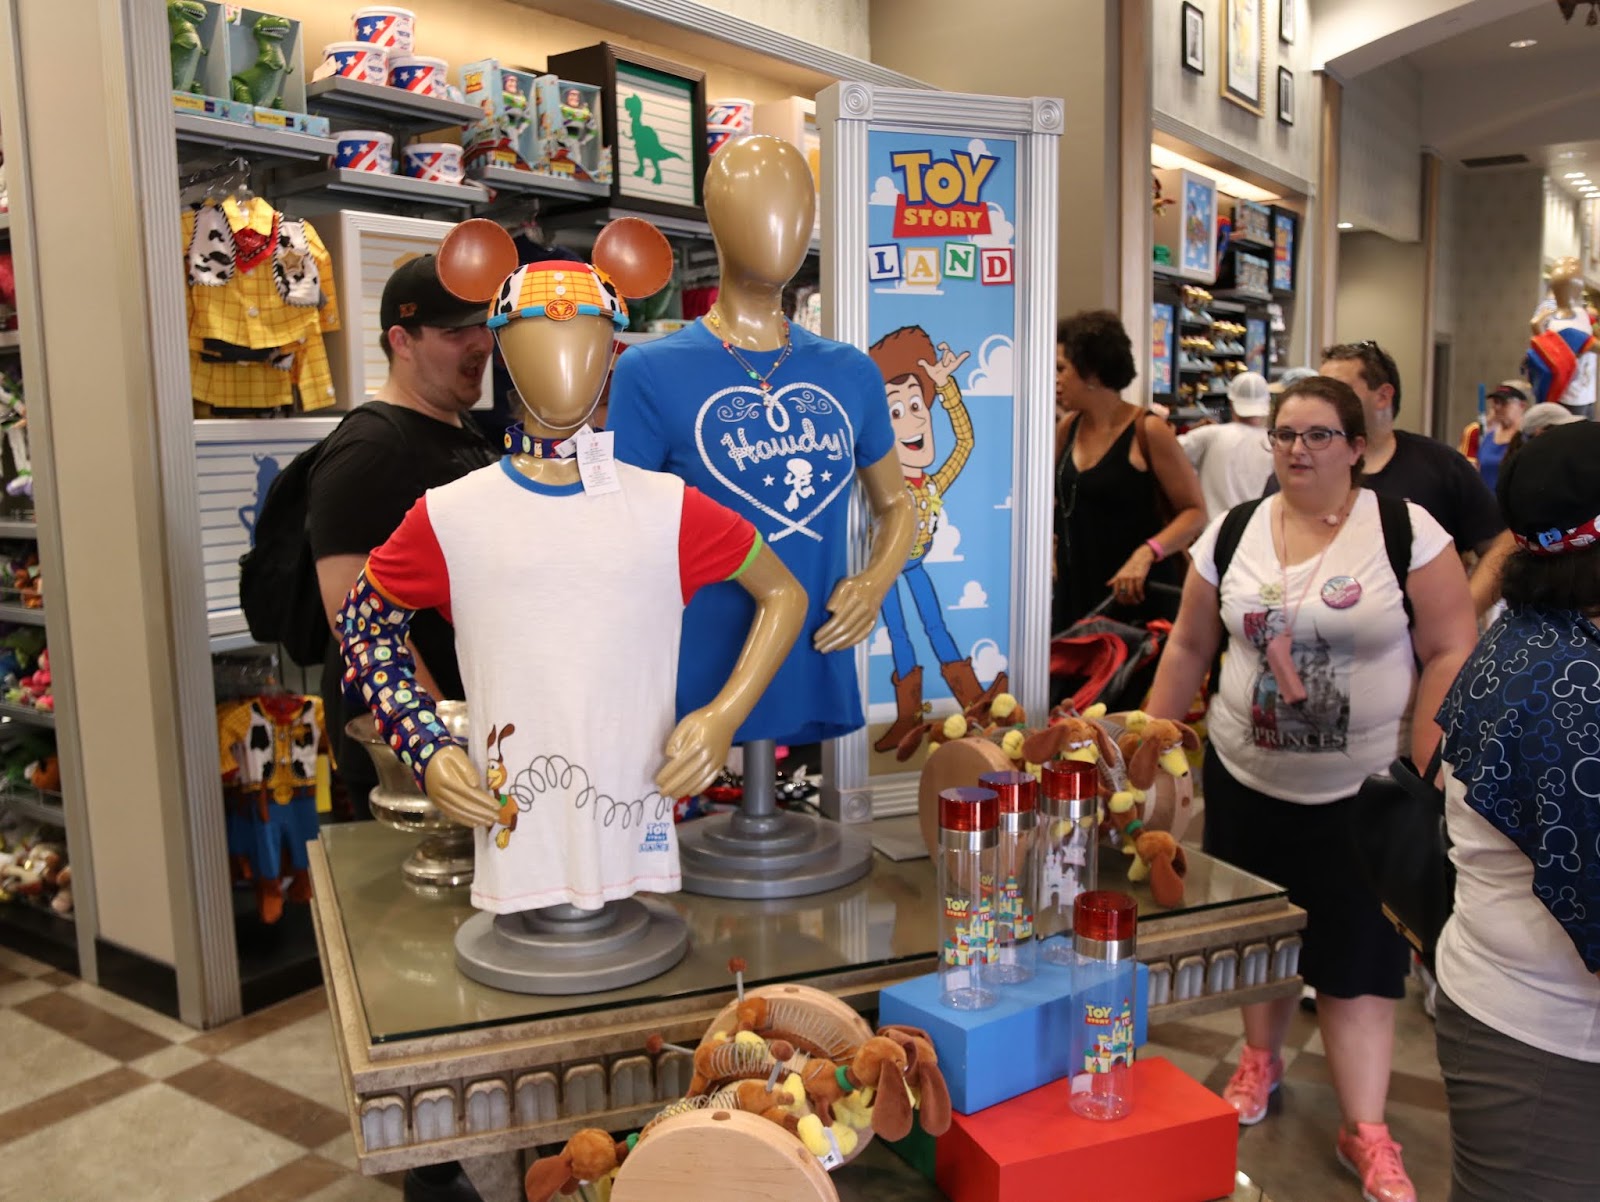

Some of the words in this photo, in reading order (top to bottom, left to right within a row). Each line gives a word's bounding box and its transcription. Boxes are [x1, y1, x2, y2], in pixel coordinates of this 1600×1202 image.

[890, 149, 1000, 207] TOY
[903, 208, 982, 229] STORY
[871, 247, 1011, 282] LAND
[945, 897, 970, 912] TOY
[1085, 1004, 1113, 1019] TOY
